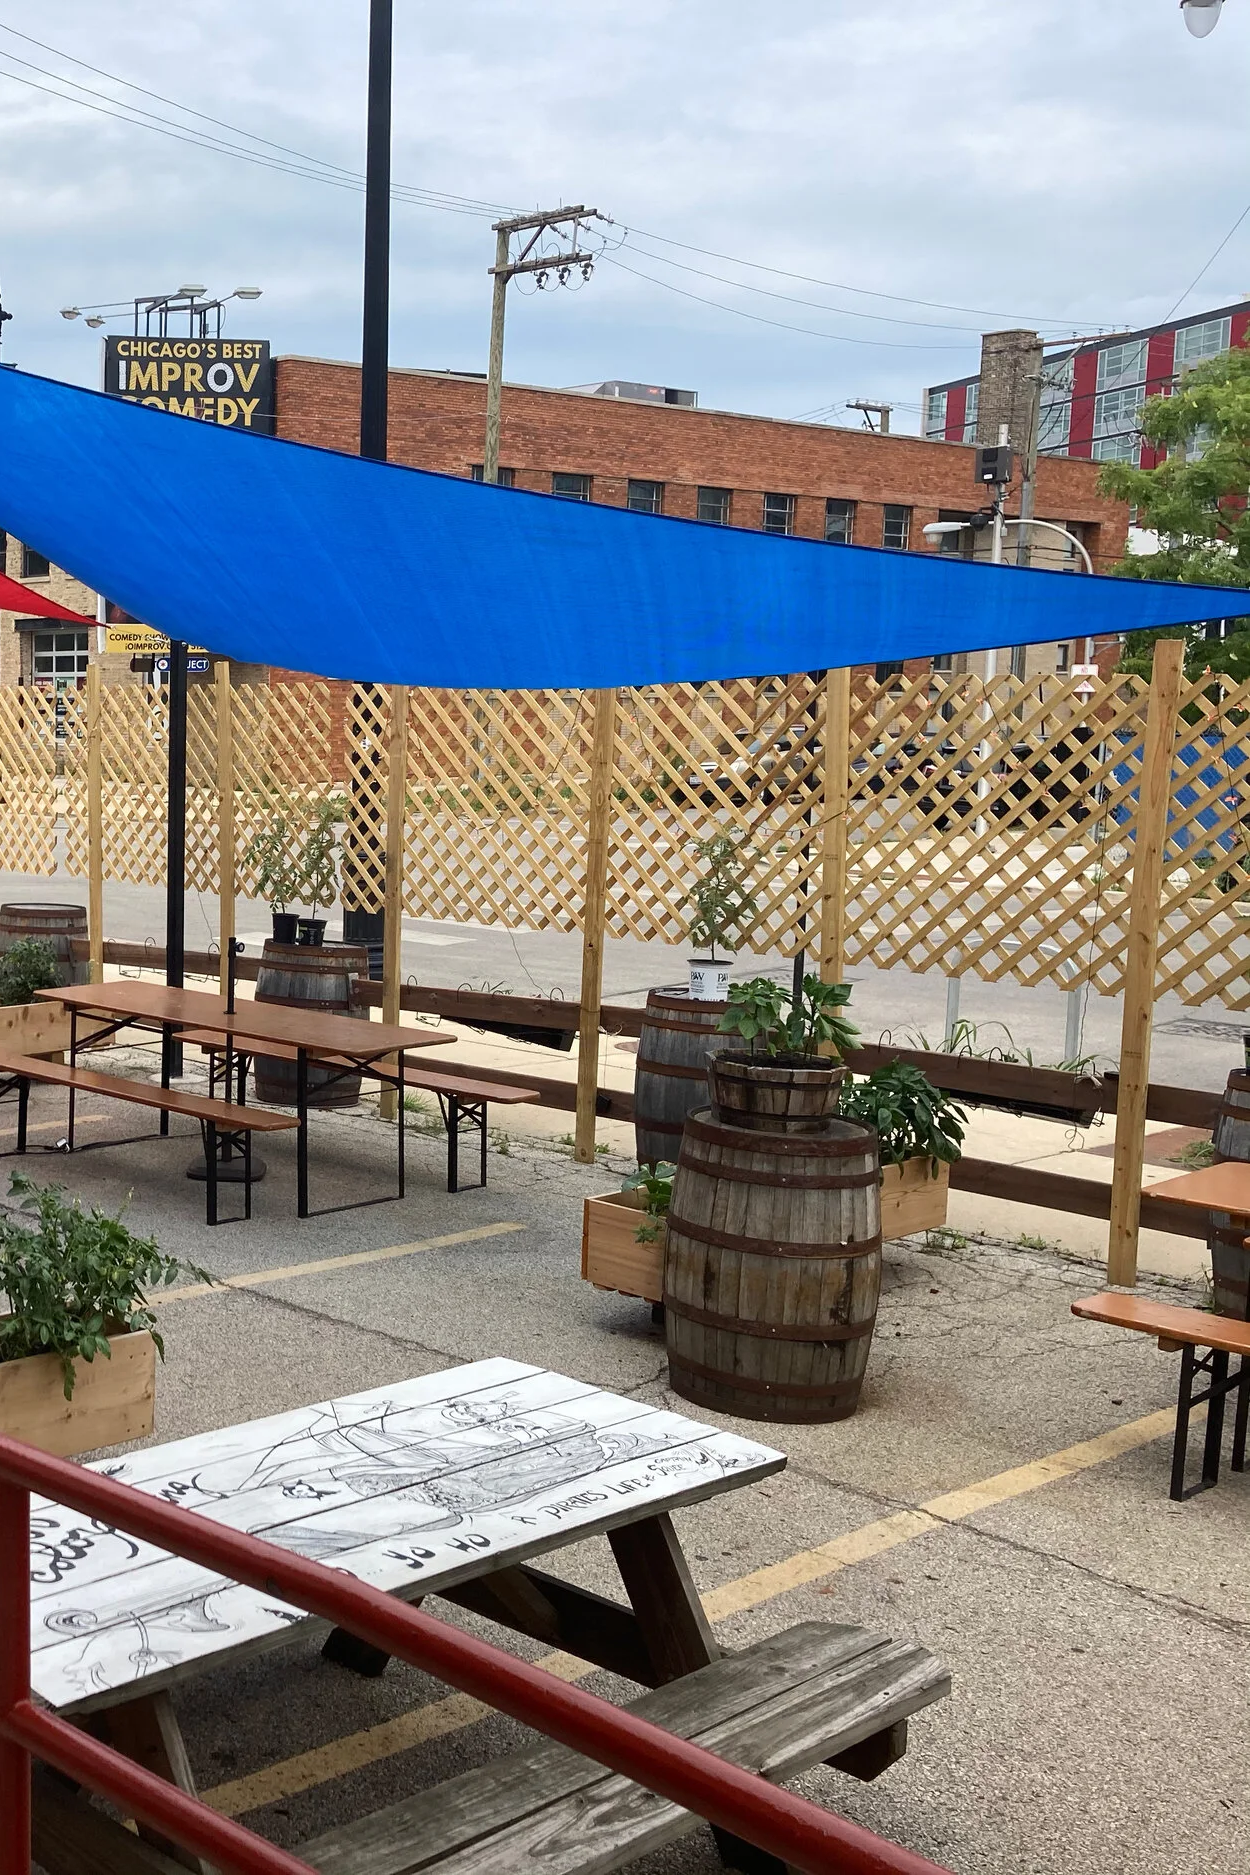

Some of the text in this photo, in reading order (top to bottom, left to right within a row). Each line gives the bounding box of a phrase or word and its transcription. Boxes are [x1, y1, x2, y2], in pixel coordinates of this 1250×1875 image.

[117, 340, 263, 359] CHICAGO'S BEST
[118, 360, 261, 393] IMPROV
[122, 395, 260, 426] MEDY
[109, 633, 142, 641] COMEDY
[187, 660, 207, 668] JECT
[538, 1490, 609, 1520] PIRATES
[603, 1478, 651, 1495] LIFE
